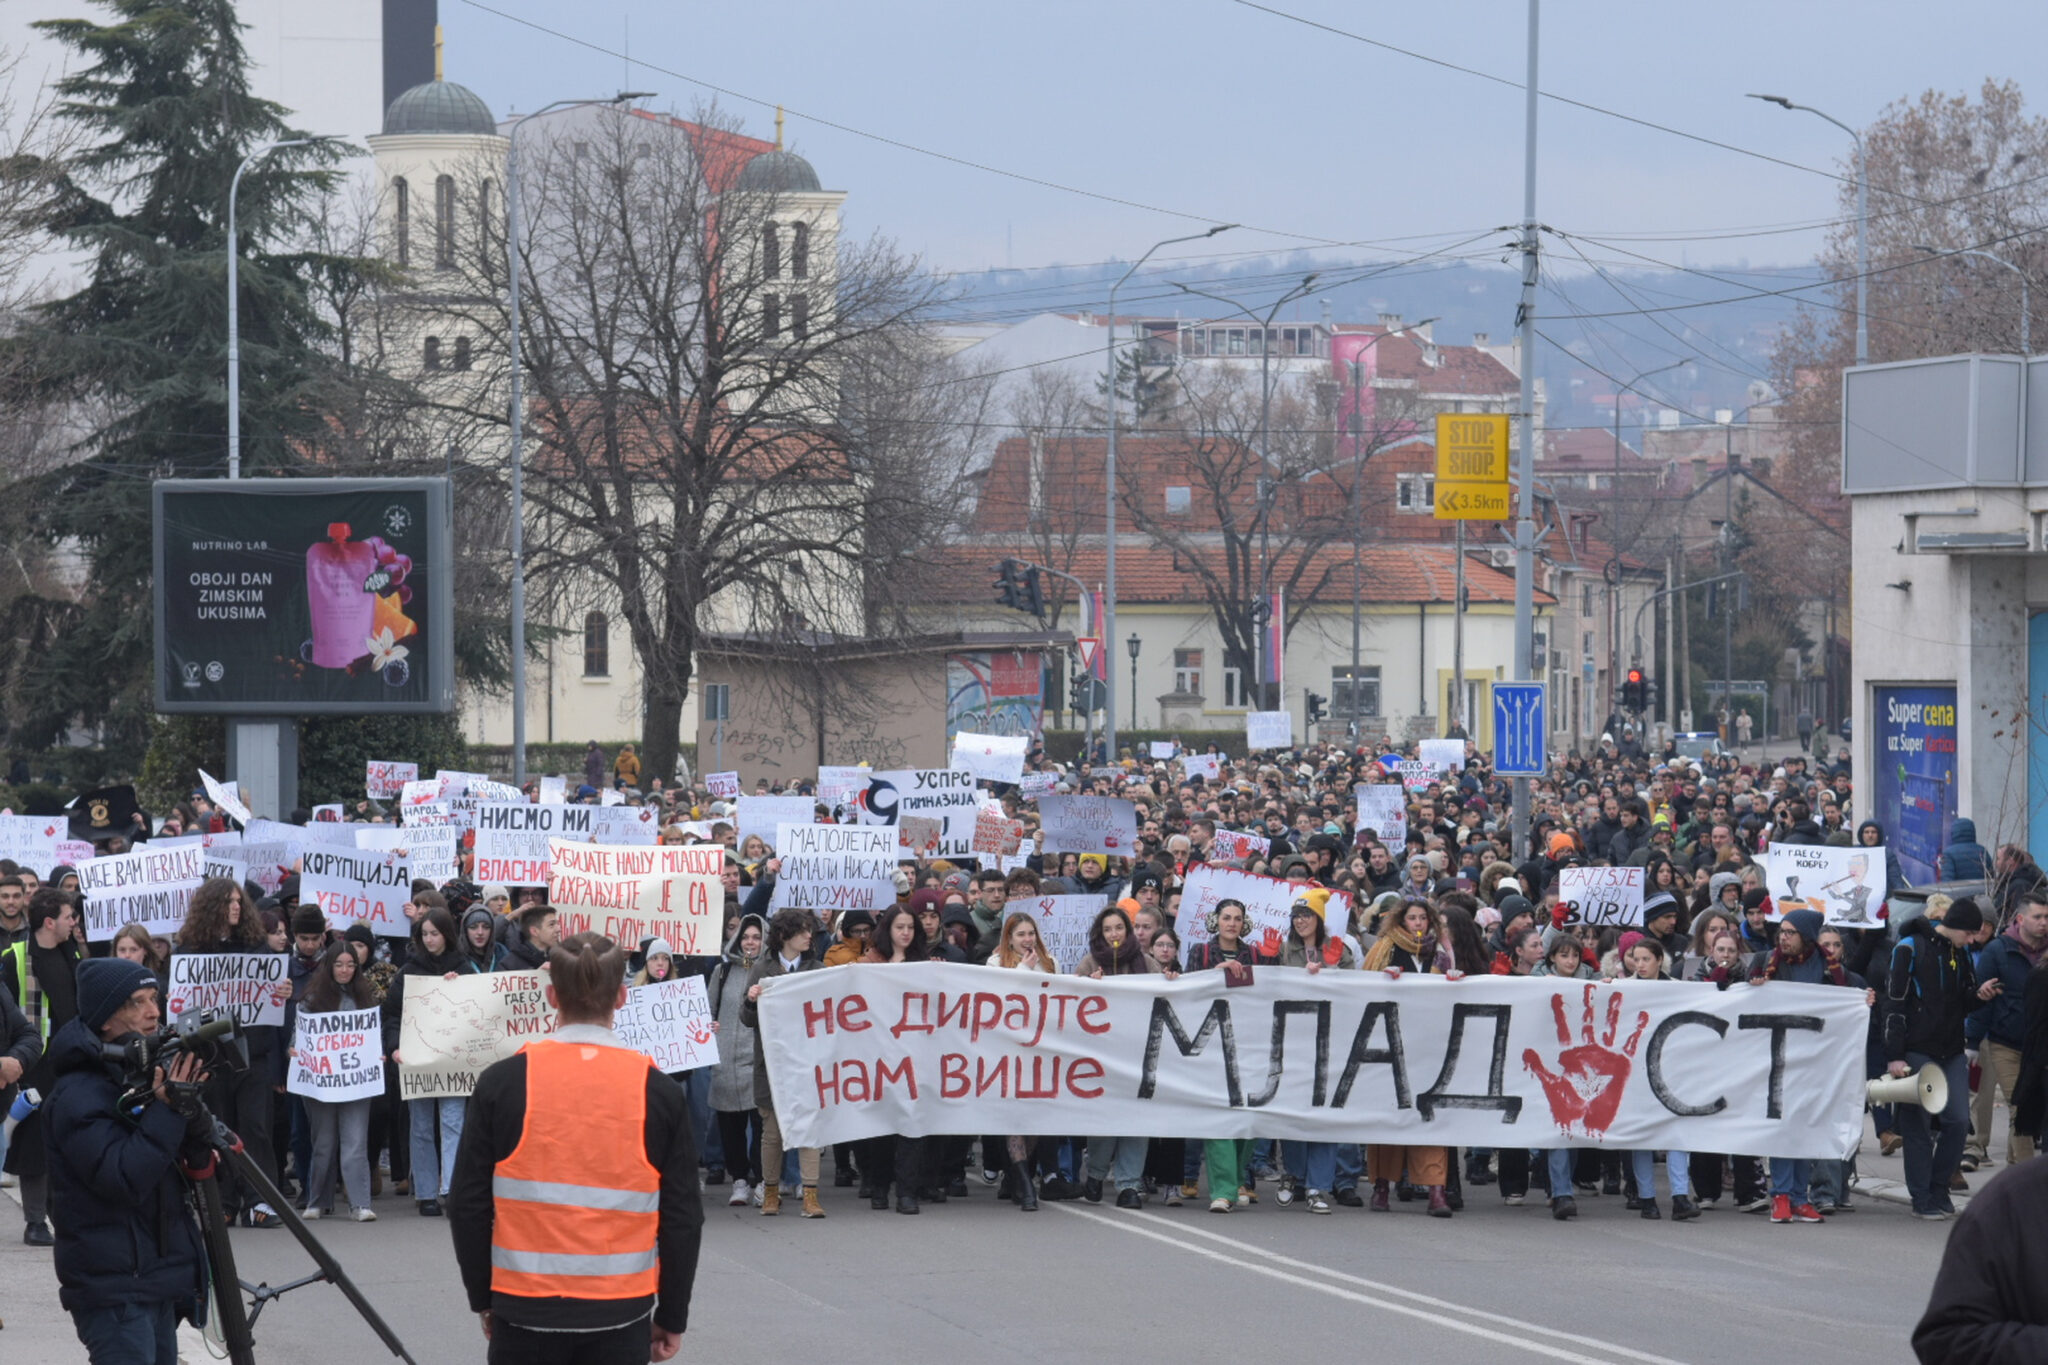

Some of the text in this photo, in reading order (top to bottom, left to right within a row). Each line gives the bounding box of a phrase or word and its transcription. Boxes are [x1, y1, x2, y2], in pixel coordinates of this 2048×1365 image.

[192, 541, 268, 550] NUTRINO LAB
[190, 572, 272, 586] OBOJI DAN
[200, 590, 263, 602] ZIMSKIM
[198, 606, 266, 619] UKUSIMA
[1888, 697, 1954, 731] Super cena
[1888, 735, 1898, 751] uz
[1900, 733, 1923, 756] Super
[914, 772, 971, 789] УСПРС
[404, 805, 441, 816] НАРОД
[903, 793, 975, 809] ГИМНАЗИЈА
[481, 807, 552, 831] НИСМО
[562, 809, 590, 832] МИ
[790, 828, 892, 852] МАЛОЛЕТАН
[929, 839, 969, 856] ИШ
[550, 845, 723, 875] УБИЈАТЕ НАШУ МЛАДОСТ
[1788, 849, 1807, 857] ГДЕ
[1810, 850, 1822, 858] СУ
[1796, 860, 1829, 869] КОБРЕ?
[115, 857, 143, 887] ВАМ
[303, 852, 409, 888] КОРУПЦИЈА
[478, 858, 551, 882] ВЛАСНИ
[657, 879, 673, 913] ЈЕ
[689, 881, 709, 915] СА
[788, 884, 874, 908] МАЛОУМАН
[1584, 886, 1621, 902] PRED
[85, 901, 104, 930] МИ
[106, 898, 117, 930] НЕ
[316, 890, 394, 923] УБИЈА.
[1564, 900, 1638, 925] BURU
[175, 956, 282, 984] СКИНУЛИ СМО
[193, 980, 266, 1008] ПАУЧИНУ
[492, 976, 538, 993] ЗАГРЕБ
[660, 979, 697, 1000] ИМЕ
[504, 990, 542, 1005] ГДЕ СУ
[652, 1001, 675, 1022] ОД
[679, 997, 710, 1018] САД
[803, 981, 1111, 1047] не дирајте
[506, 1016, 539, 1037] NOVI
[317, 1033, 364, 1052] СРБИЈУ
[340, 1052, 361, 1070] ES
[316, 1065, 380, 1088] CATALUNYA
[404, 1071, 477, 1095] НАША МУКА
[815, 1053, 1106, 1109] нам више
